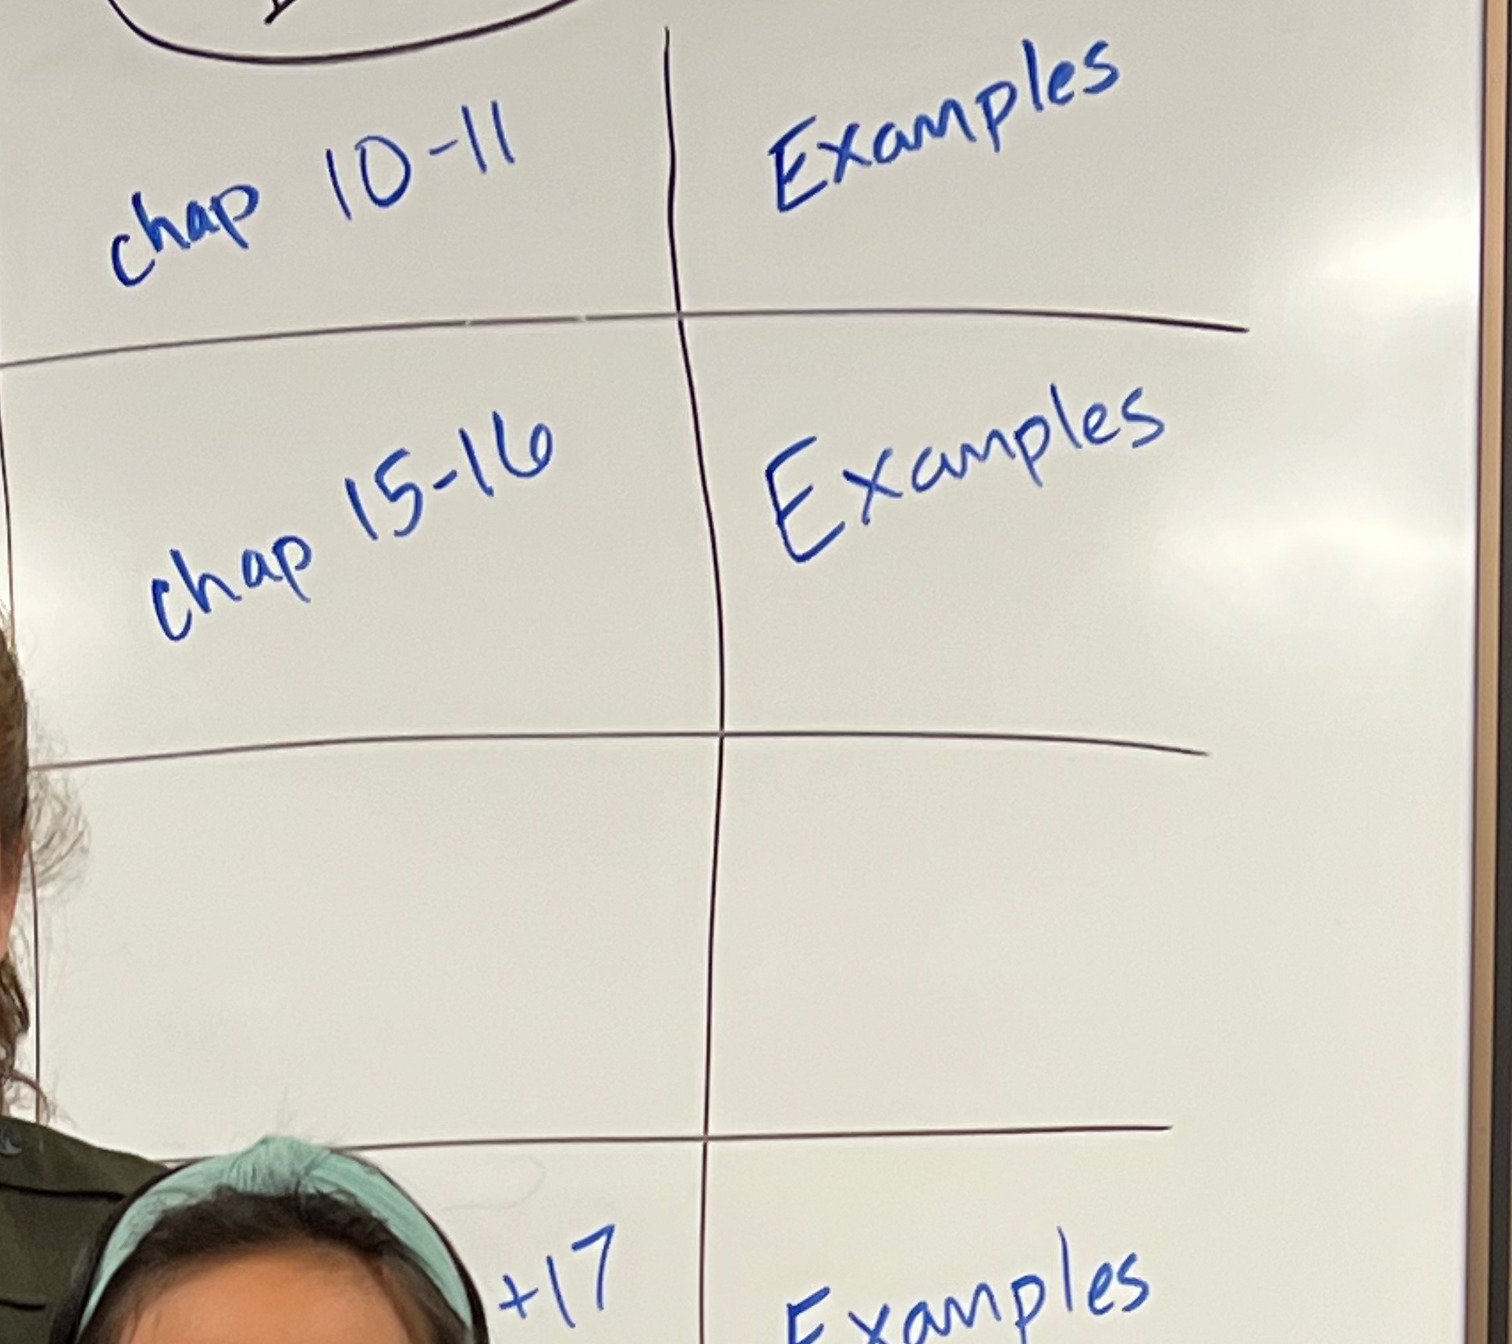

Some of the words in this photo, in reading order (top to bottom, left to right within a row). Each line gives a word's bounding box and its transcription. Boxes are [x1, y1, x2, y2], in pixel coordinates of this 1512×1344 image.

[111, 184, 259, 288] chap
[325, 100, 515, 221] 10-11
[767, 39, 1119, 214] Examples
[151, 535, 312, 642] chap
[344, 410, 553, 541] 15-16
[764, 383, 1164, 564] Examples
